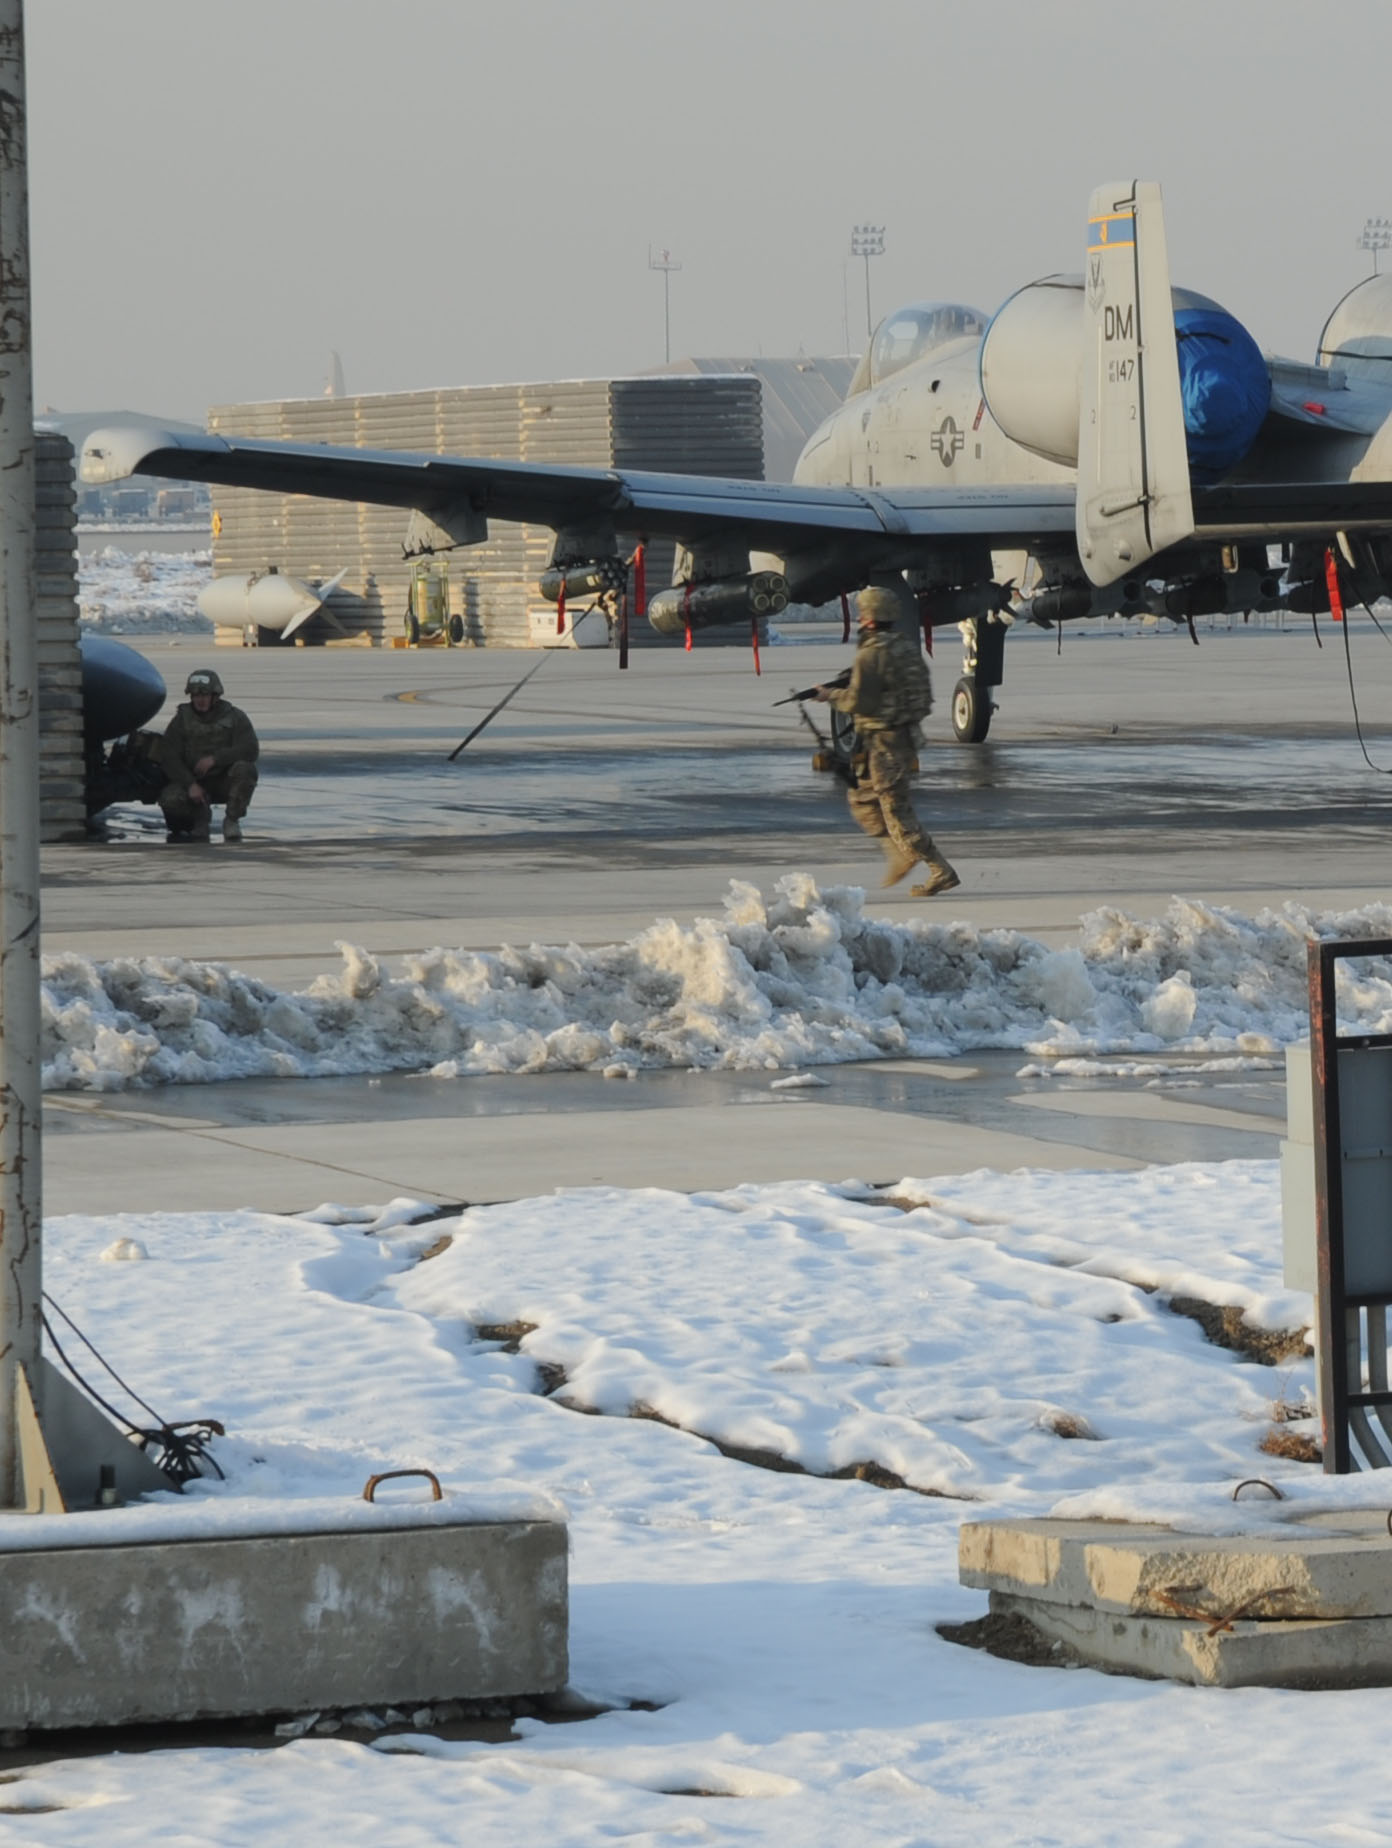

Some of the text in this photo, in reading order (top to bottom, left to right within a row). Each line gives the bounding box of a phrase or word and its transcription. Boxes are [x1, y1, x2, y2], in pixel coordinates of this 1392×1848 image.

[1105, 304, 1133, 341] DM
[1116, 359, 1135, 382] 147
[1130, 404, 1137, 420] 2
